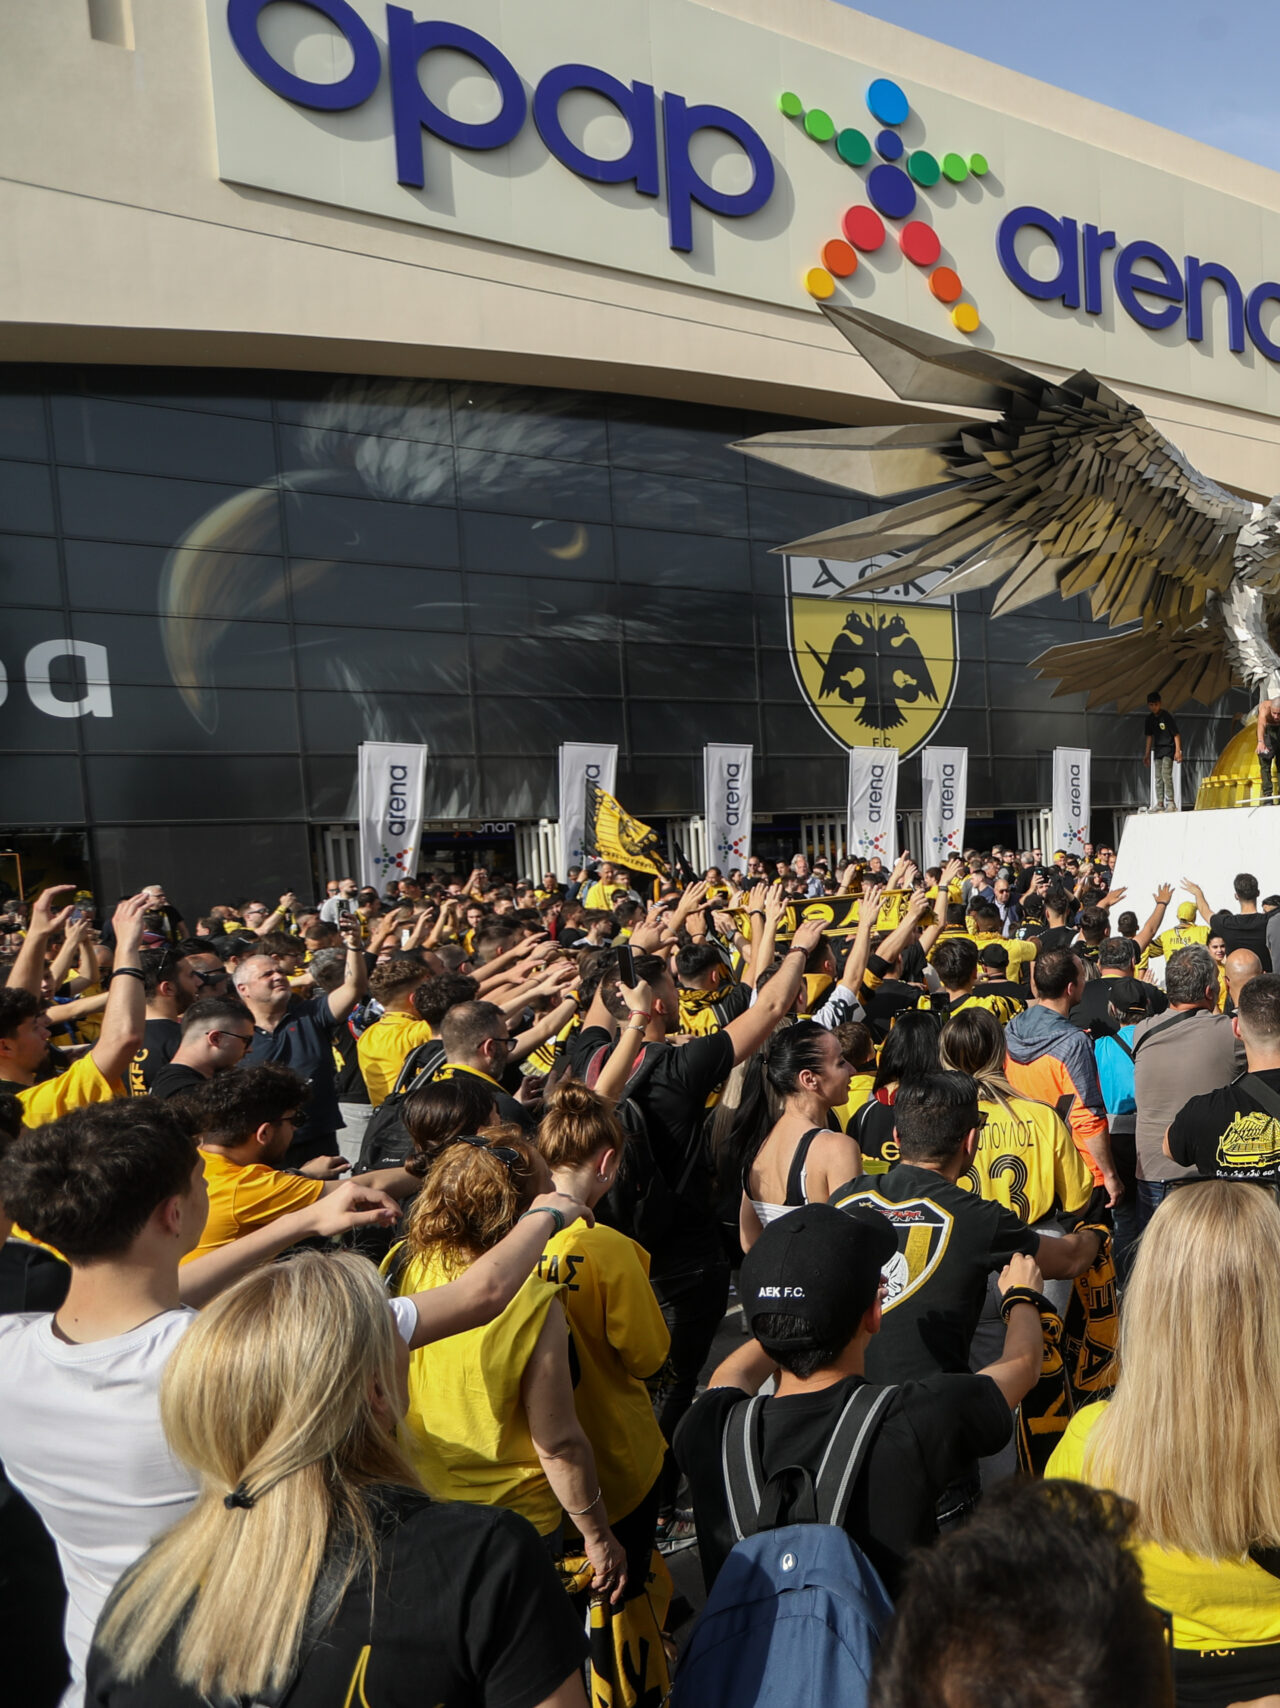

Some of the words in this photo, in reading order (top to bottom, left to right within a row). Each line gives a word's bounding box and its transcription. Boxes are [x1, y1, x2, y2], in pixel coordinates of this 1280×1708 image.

[227, 0, 775, 252] opap
[388, 764, 407, 836] arena
[726, 763, 741, 826] arena
[869, 765, 884, 822] arena
[942, 764, 955, 820] arena
[1071, 764, 1081, 817] arena
[758, 1287, 781, 1298] AEK
[784, 1287, 806, 1298] F.C.
